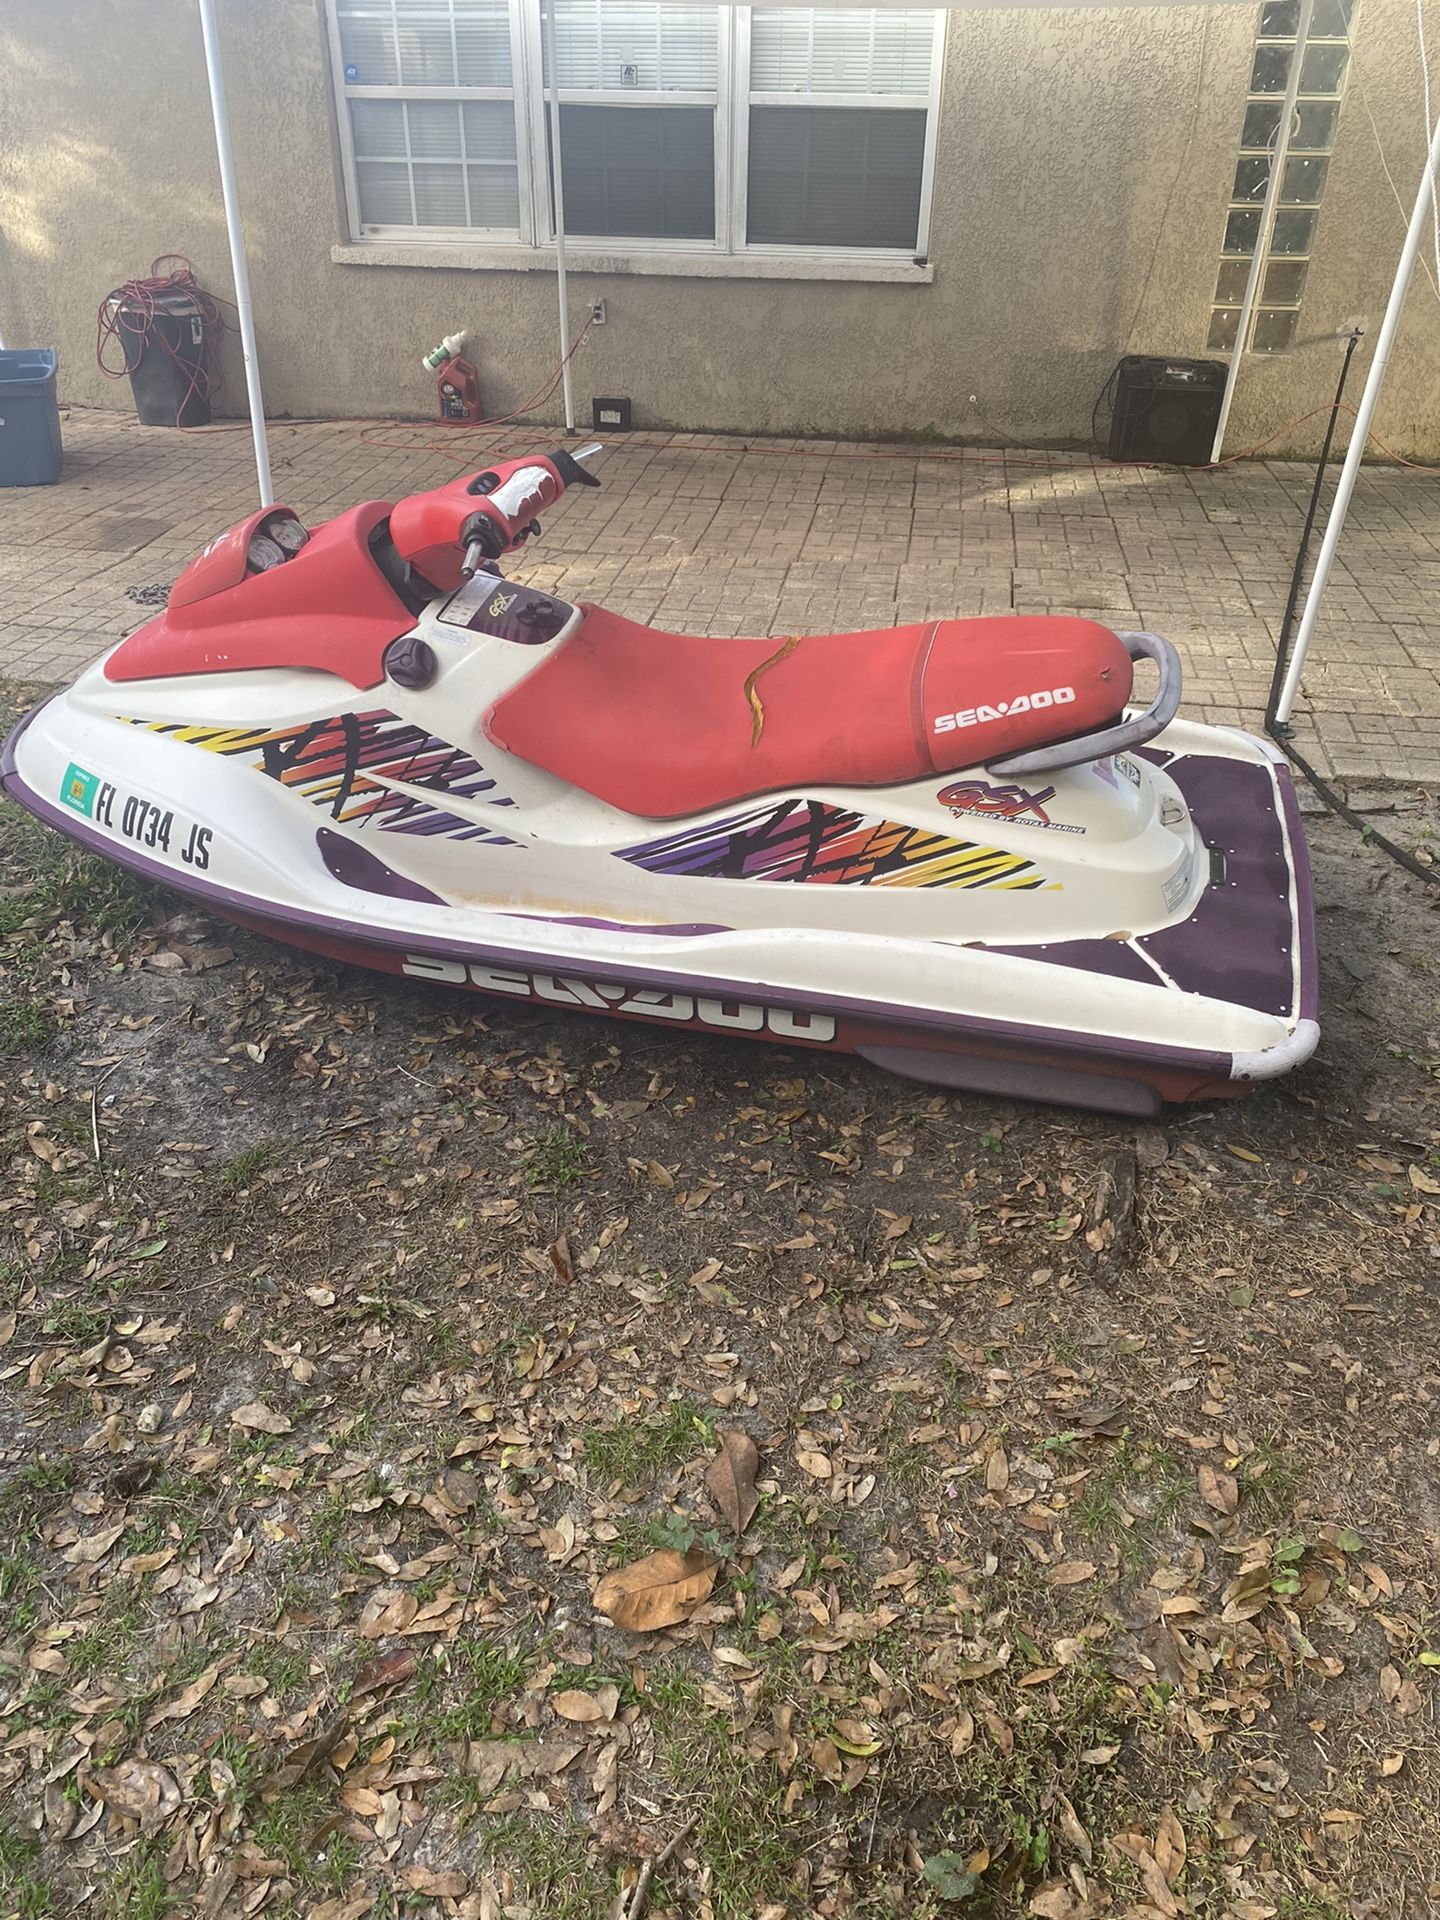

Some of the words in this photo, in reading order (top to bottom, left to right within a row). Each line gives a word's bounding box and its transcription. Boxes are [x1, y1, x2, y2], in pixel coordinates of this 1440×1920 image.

[489, 592, 511, 617] GSX
[936, 780, 1056, 823] GSX
[96, 782, 117, 828] FL
[122, 796, 174, 853] 0734
[181, 823, 213, 870] JS
[950, 806, 997, 820] POWERED
[1014, 817, 1048, 829] ROTAX
[1047, 822, 1085, 835] MARINE
